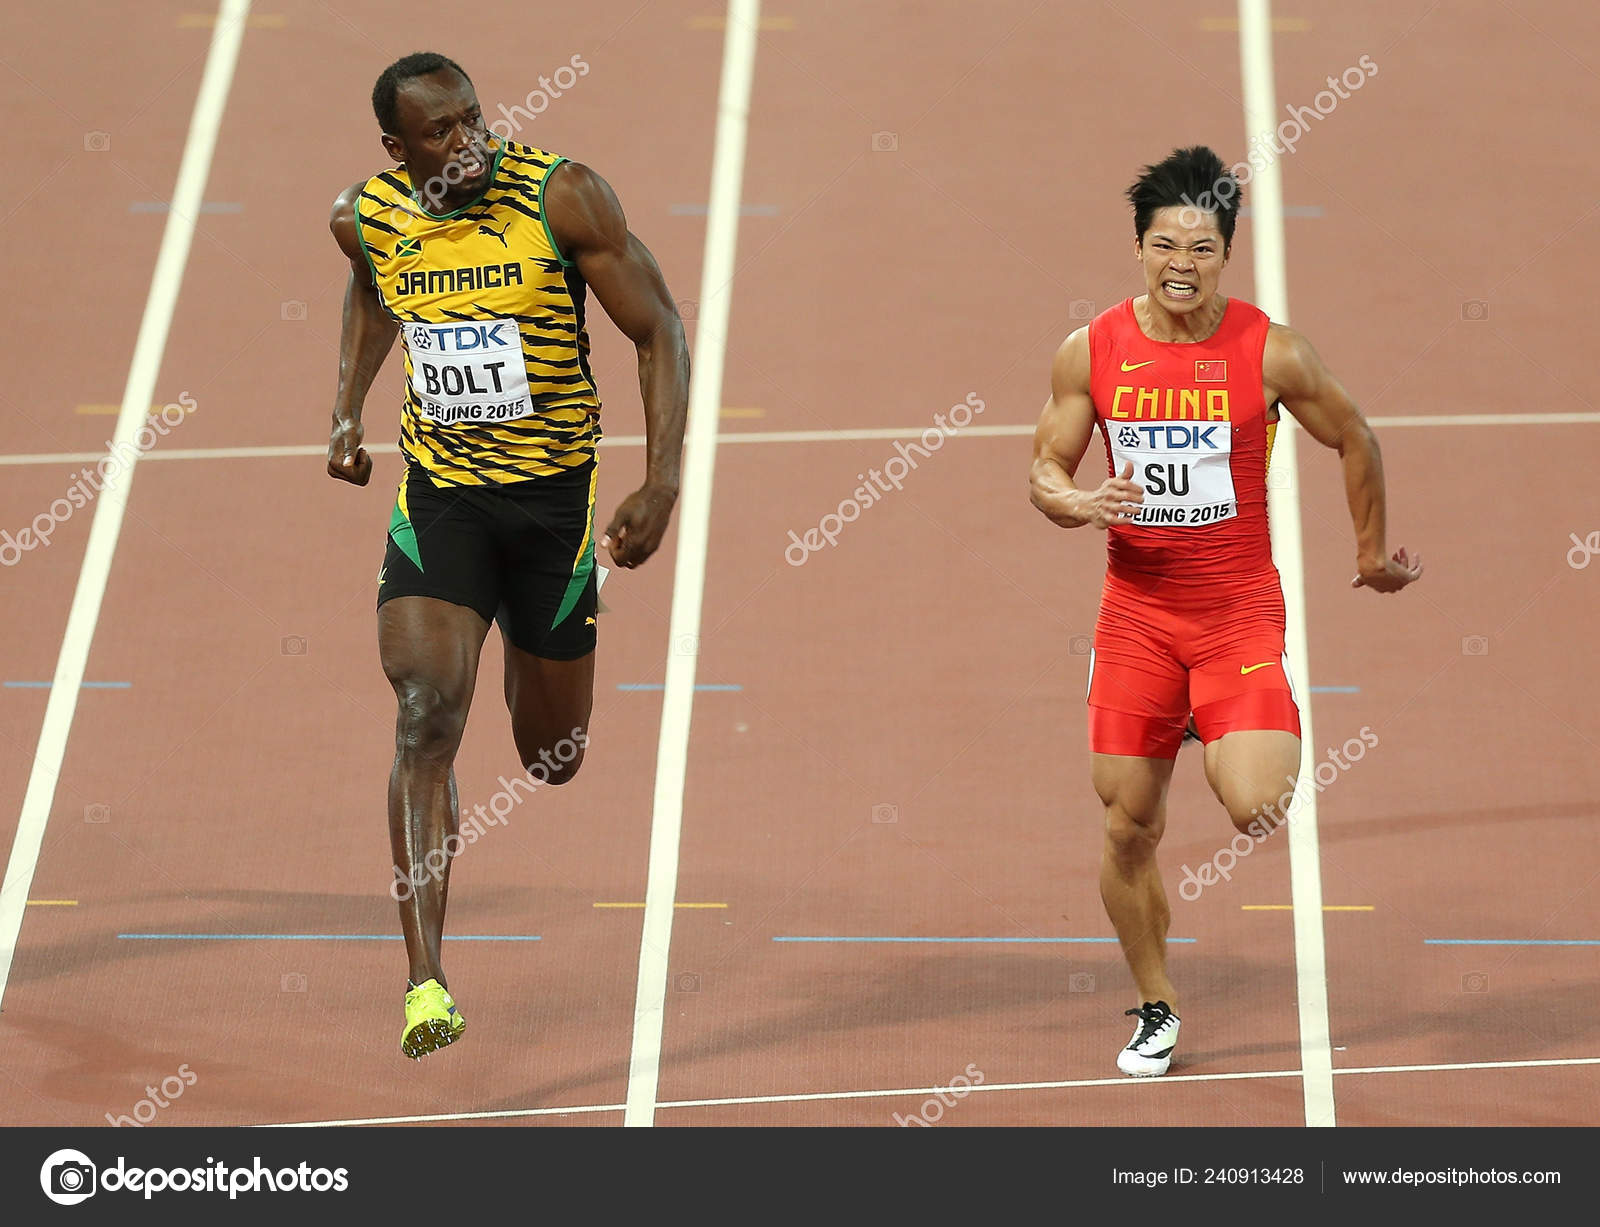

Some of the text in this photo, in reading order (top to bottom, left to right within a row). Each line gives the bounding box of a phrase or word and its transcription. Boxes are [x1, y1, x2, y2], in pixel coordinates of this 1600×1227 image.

[395, 262, 524, 296] JAMAICA
[429, 323, 509, 352] TDK
[422, 361, 505, 397] BOLT
[426, 399, 525, 422] BEIJING 2015
[1111, 385, 1230, 422] CHINA
[1138, 425, 1219, 450] TDK
[1144, 463, 1190, 497] SU
[1122, 503, 1231, 523] EIJING 2015
